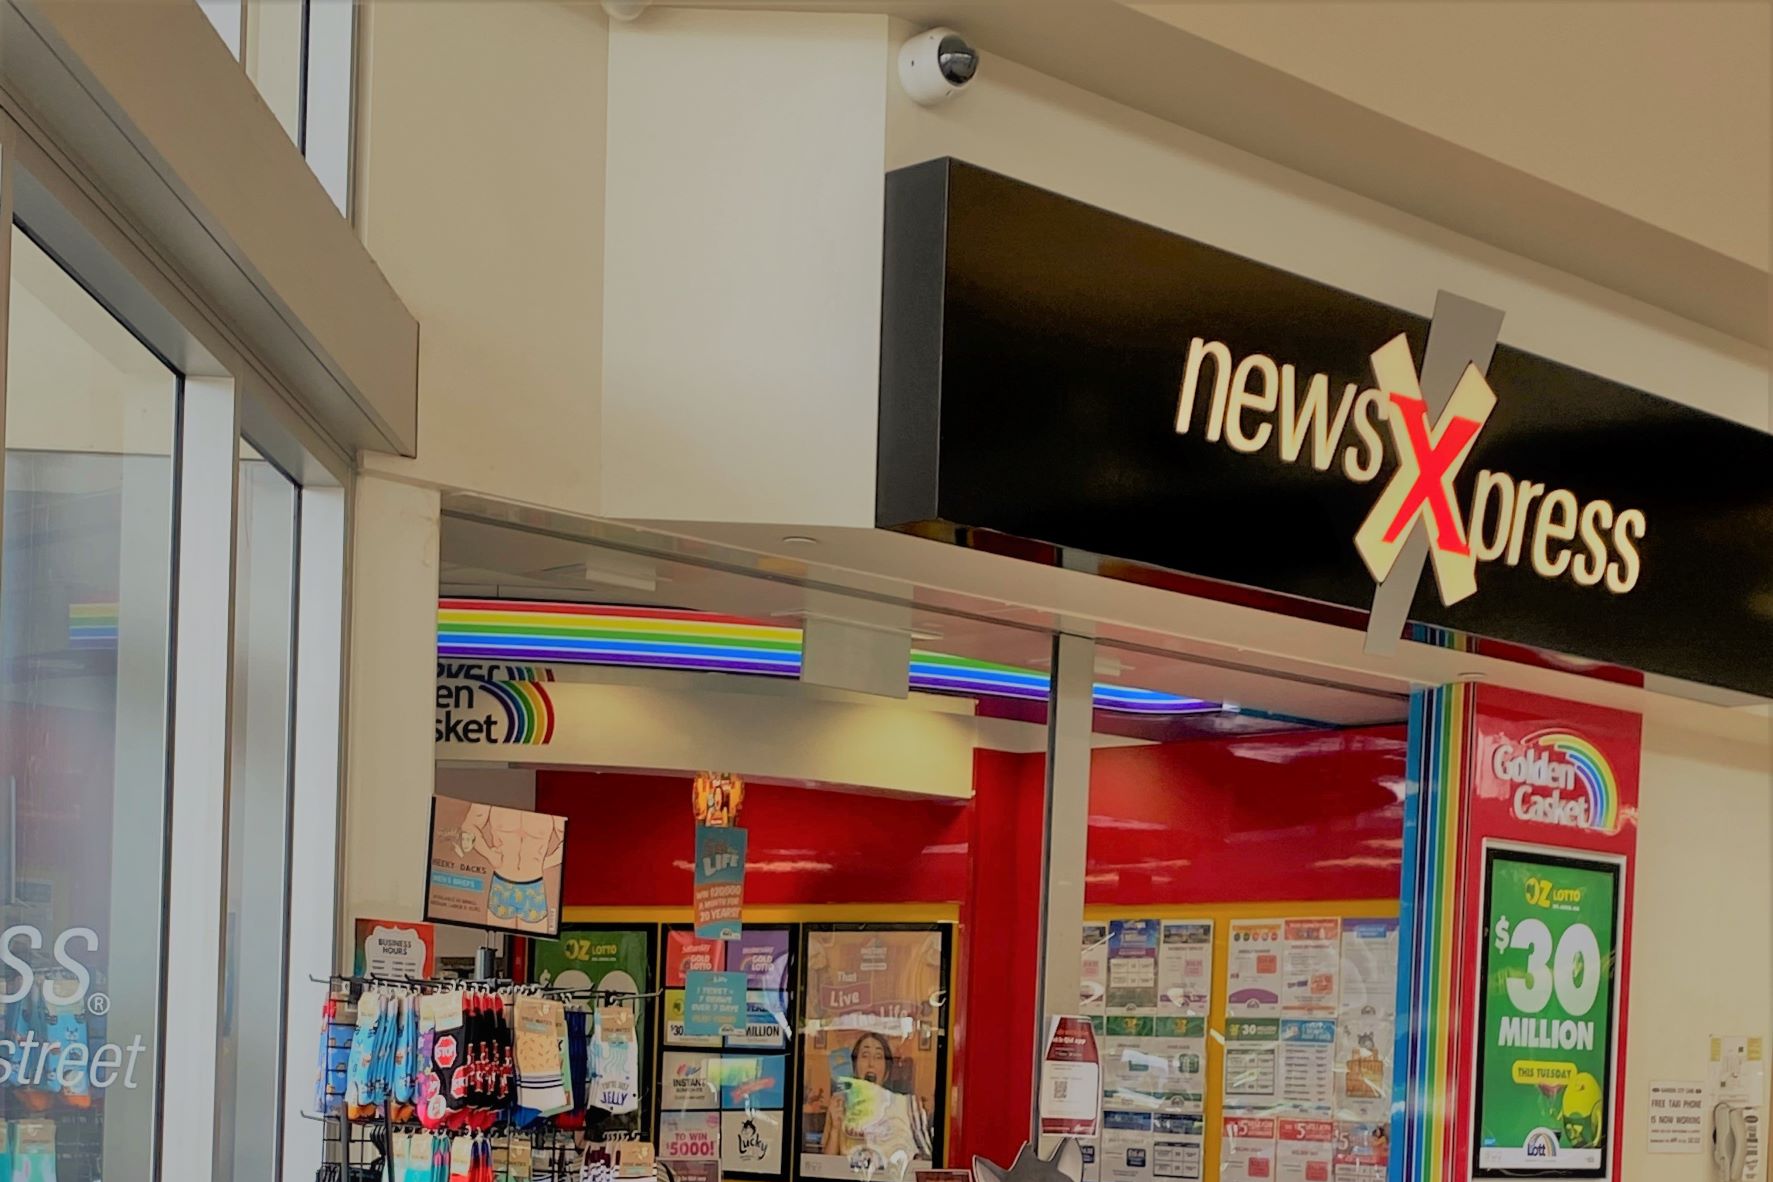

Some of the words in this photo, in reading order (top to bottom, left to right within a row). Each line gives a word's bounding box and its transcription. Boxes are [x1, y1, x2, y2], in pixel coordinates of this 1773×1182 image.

[1493, 744, 1575, 790] Golden
[1514, 785, 1591, 828] Casket
[1552, 888, 1582, 902] LOTTO
[591, 944, 617, 955] LOTTO
[830, 990, 860, 1008] Live
[1498, 1016, 1595, 1051] MILLION
[1518, 1067, 1534, 1078] THIS
[1536, 1067, 1572, 1079] TUESDAY
[600, 1090, 628, 1106] JELLY
[1651, 1099, 1665, 1108] FREE
[1659, 1115, 1673, 1124] NOW
[690, 1132, 707, 1140] WIN
[738, 1133, 768, 1159] Lucky
